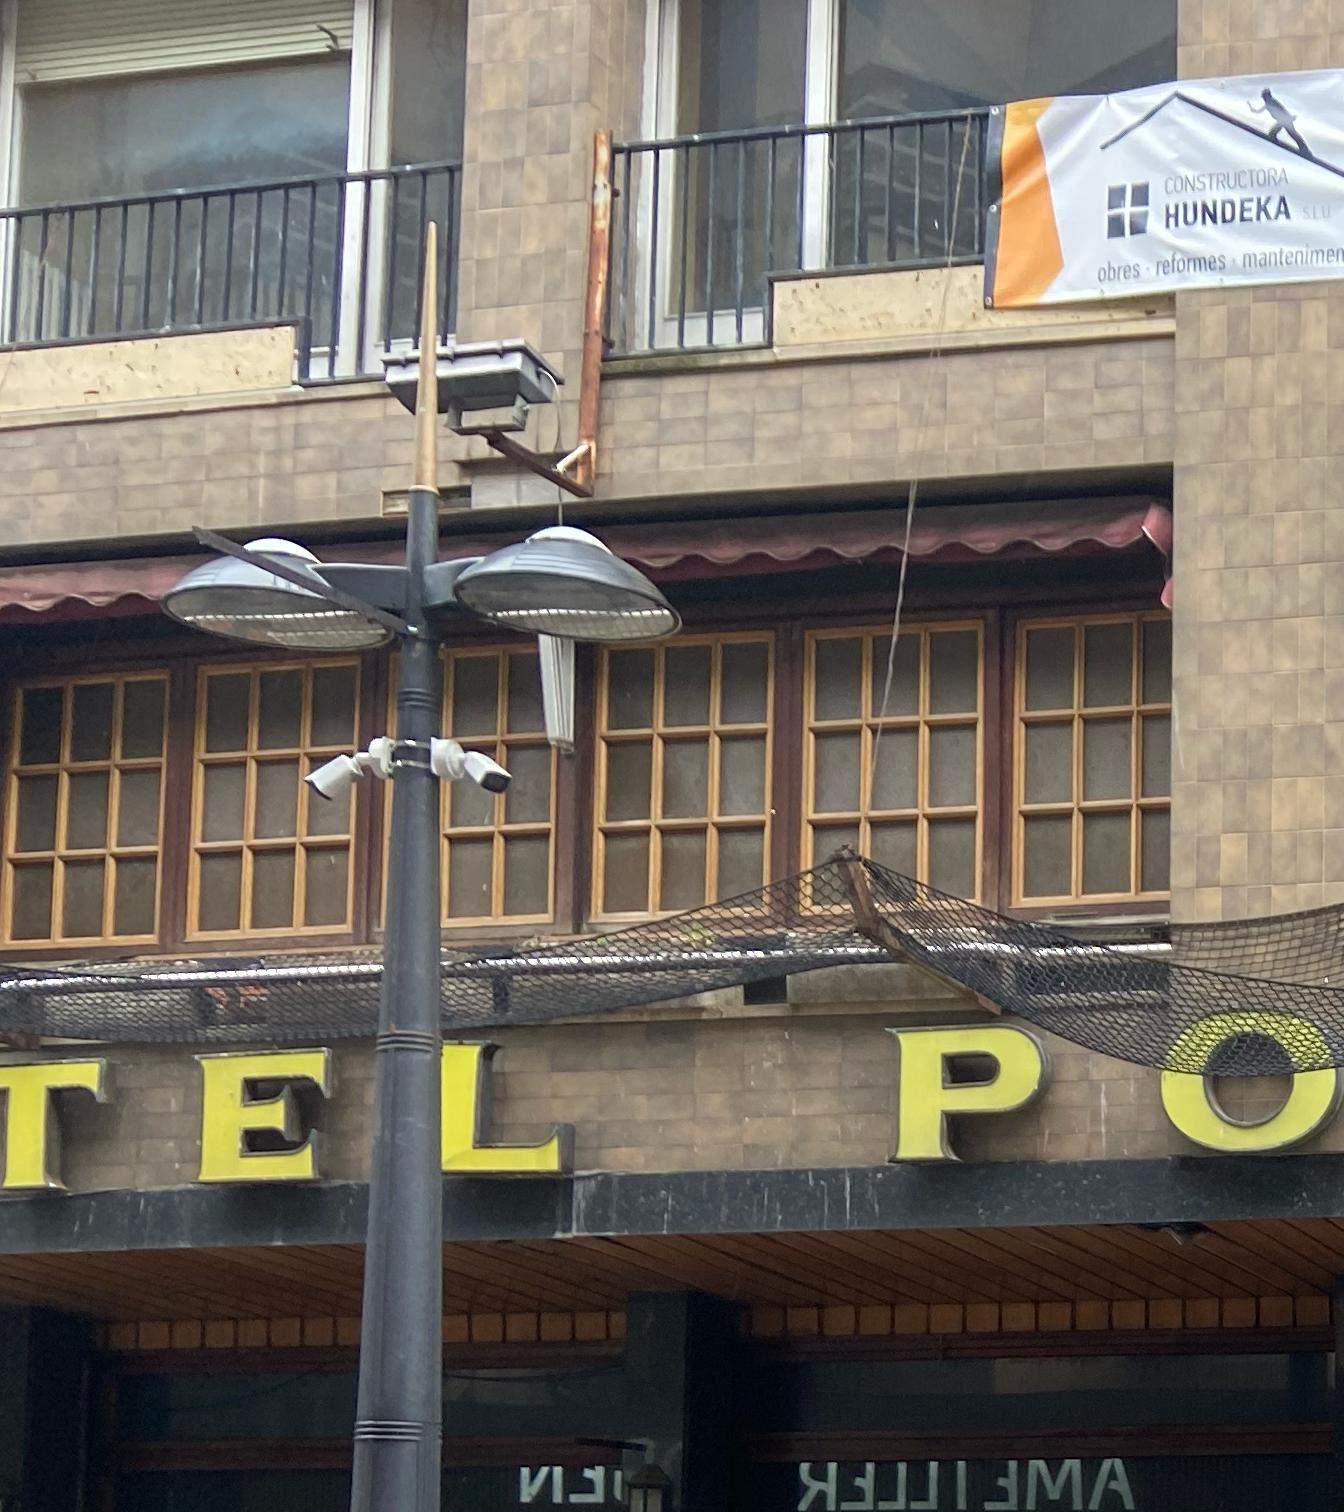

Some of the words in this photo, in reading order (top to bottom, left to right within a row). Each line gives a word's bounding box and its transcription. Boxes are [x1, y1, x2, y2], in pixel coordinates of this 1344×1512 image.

[1164, 167, 1289, 195] CONSTRUCTORA
[1164, 195, 1292, 229] HUNDEKA
[1097, 259, 1141, 283] obres
[1155, 251, 1227, 277] reformes
